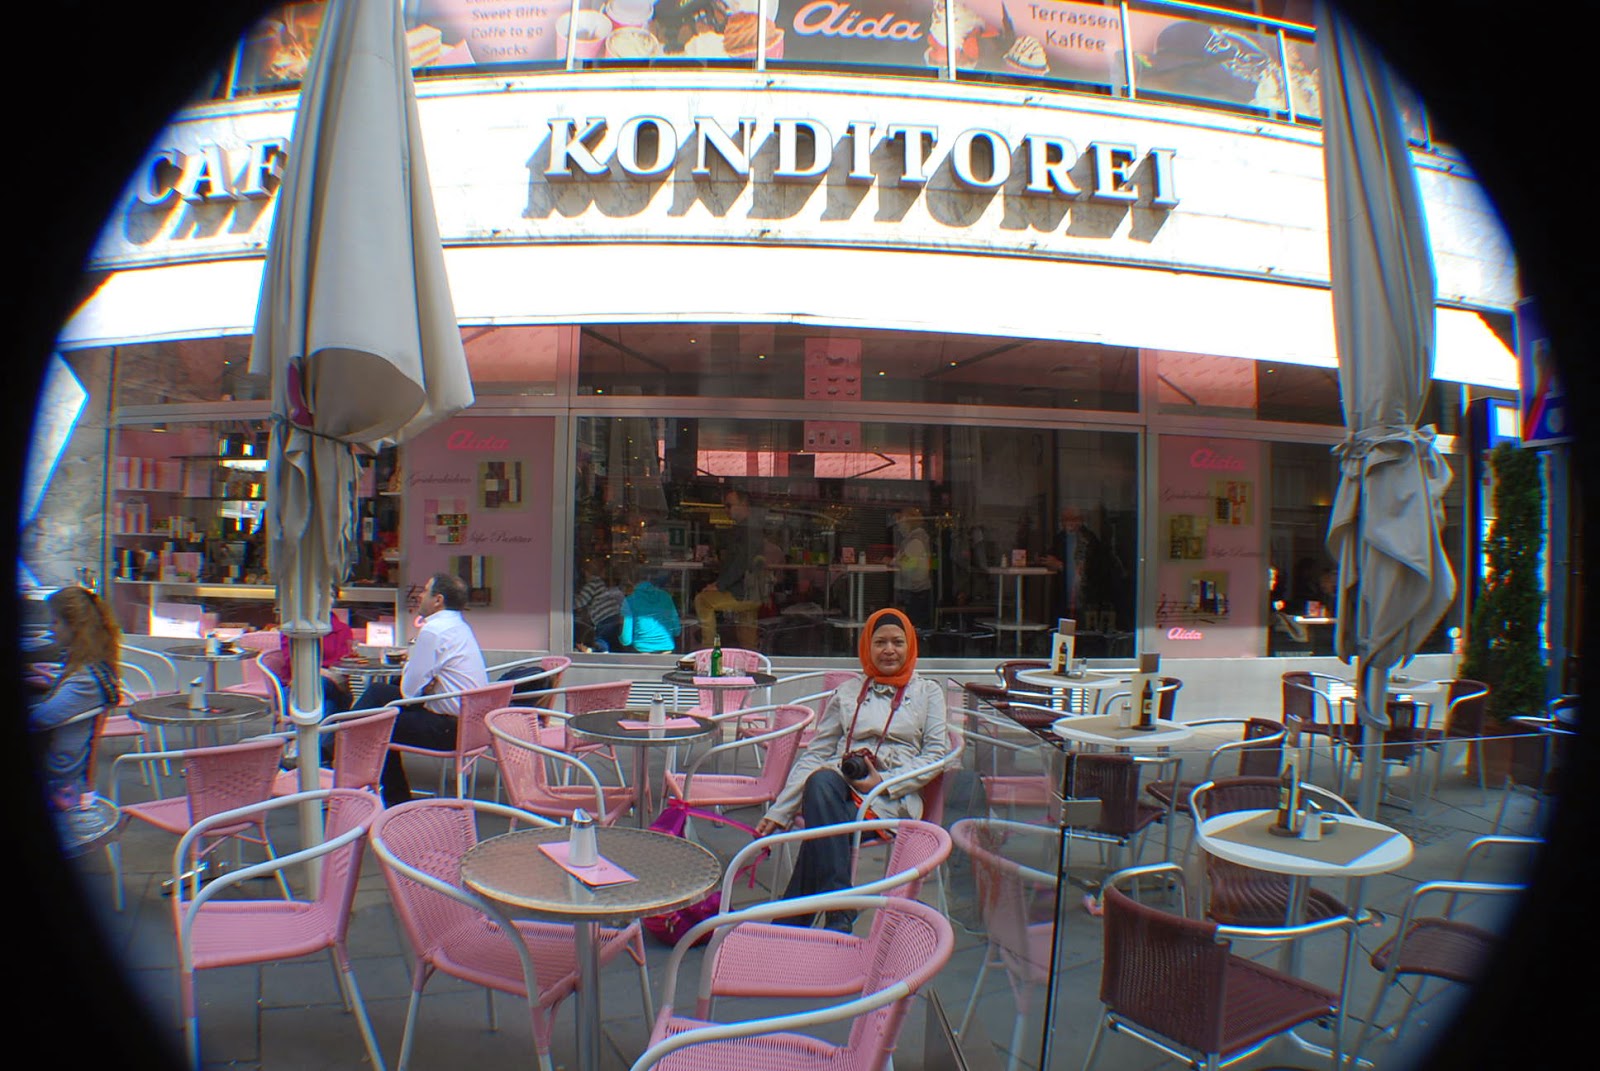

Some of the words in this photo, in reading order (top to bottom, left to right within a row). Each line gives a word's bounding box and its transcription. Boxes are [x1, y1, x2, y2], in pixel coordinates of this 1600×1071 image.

[471, 8, 512, 20] Sweet
[793, 0, 923, 41] Aida
[1028, 3, 1119, 30] Terrassen
[509, 26, 523, 37] to
[526, 26, 543, 39] go
[1045, 29, 1106, 51] Kaffee
[480, 43, 529, 57] Snacks
[135, 137, 290, 205] CAF
[543, 115, 1180, 209] KONDITOREI
[447, 429, 511, 450] Aida
[1190, 449, 1246, 471] Aida
[1167, 627, 1203, 641] Aida
